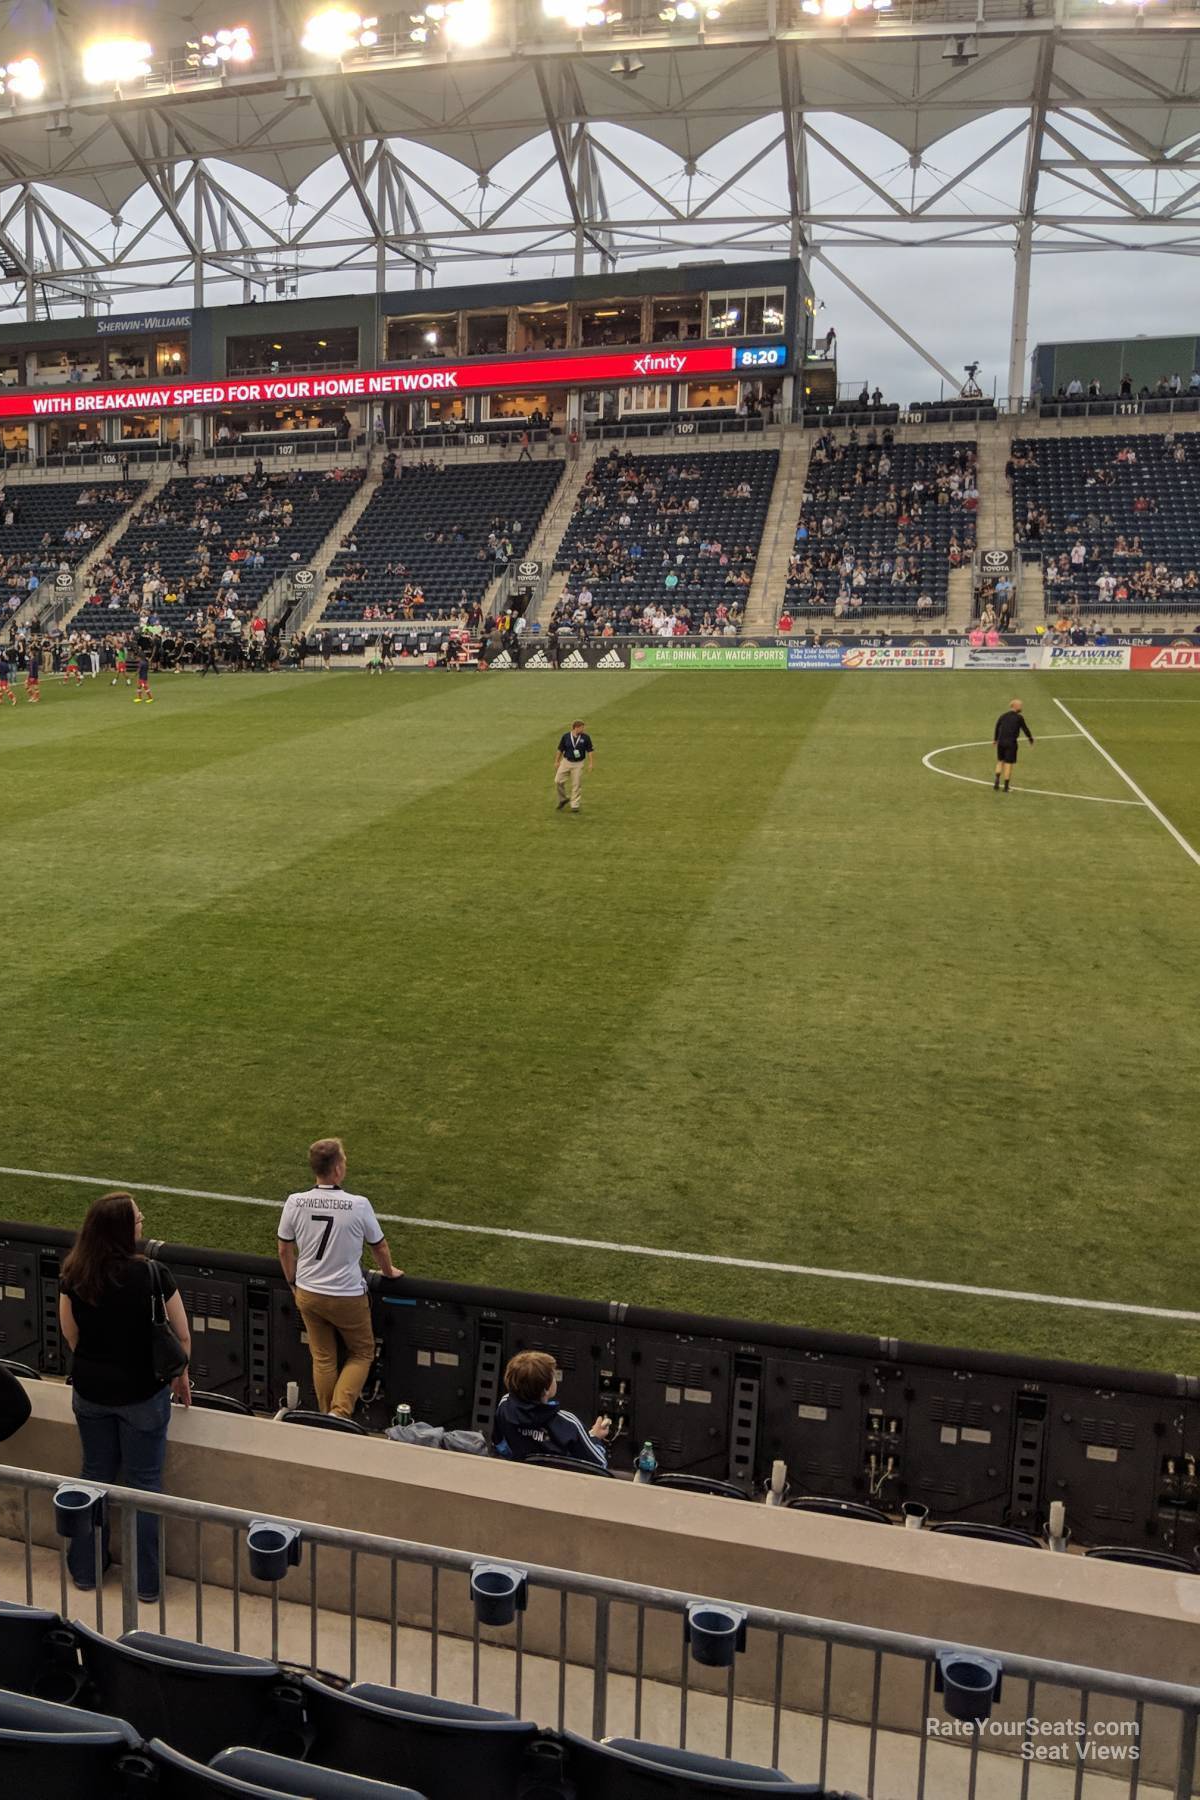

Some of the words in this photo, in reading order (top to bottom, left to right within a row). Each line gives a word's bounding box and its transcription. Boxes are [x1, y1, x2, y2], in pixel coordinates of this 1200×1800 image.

[742, 350, 779, 365] 8:20
[633, 355, 687, 374] xfinity
[33, 398, 72, 414] WITH
[74, 391, 172, 411] BREAKAWAY
[173, 387, 225, 406] SPEED
[227, 385, 261, 401] FOR
[264, 382, 311, 400] YOUR
[313, 377, 365, 396] HOME
[368, 372, 458, 393] NETWORK
[1120, 403, 1139, 414] 111
[903, 413, 922, 424] 110
[676, 424, 694, 434] 109
[468, 435, 485, 445] 108
[278, 446, 293, 455] 107
[102, 455, 116, 464] 106
[672, 650, 698, 660] DRINK.
[725, 650, 751, 660] WATCH
[870, 649, 891, 657] DOC
[1050, 647, 1123, 658] DELAWARE
[866, 658, 901, 666] CAVITY
[905, 658, 946, 666] BUSTERS
[1050, 656, 1123, 667] EXPRESS
[296, 1198, 353, 1210] SCHWEINSTEIGER
[311, 1214, 334, 1260] 7
